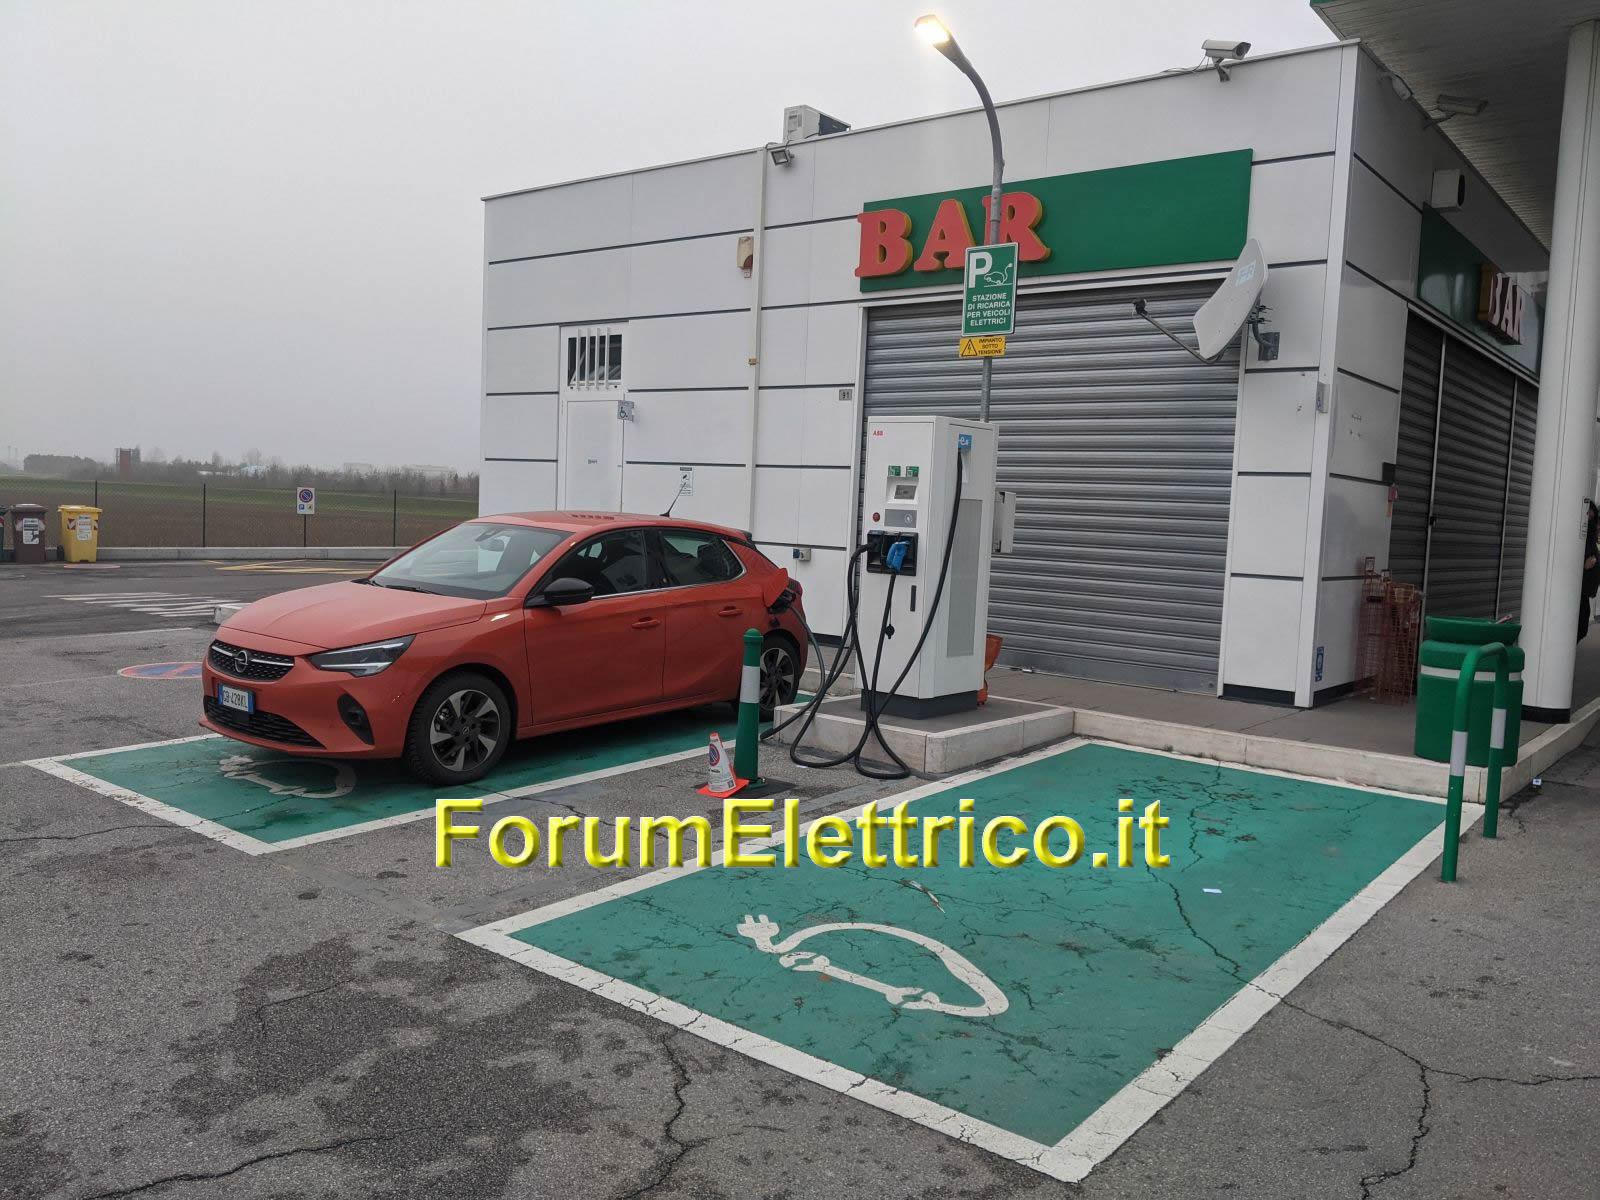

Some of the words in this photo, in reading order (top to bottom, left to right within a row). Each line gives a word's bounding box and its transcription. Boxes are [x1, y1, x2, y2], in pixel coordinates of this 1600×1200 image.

[855, 191, 1051, 278] BAR
[968, 251, 993, 289] P
[972, 292, 1007, 302] STAZIONE
[967, 303, 976, 311] DI
[977, 301, 1011, 310] RICARICA
[966, 310, 981, 319] PER
[983, 308, 1011, 317] VEICOLI
[970, 317, 1006, 327] ELETTRICI
